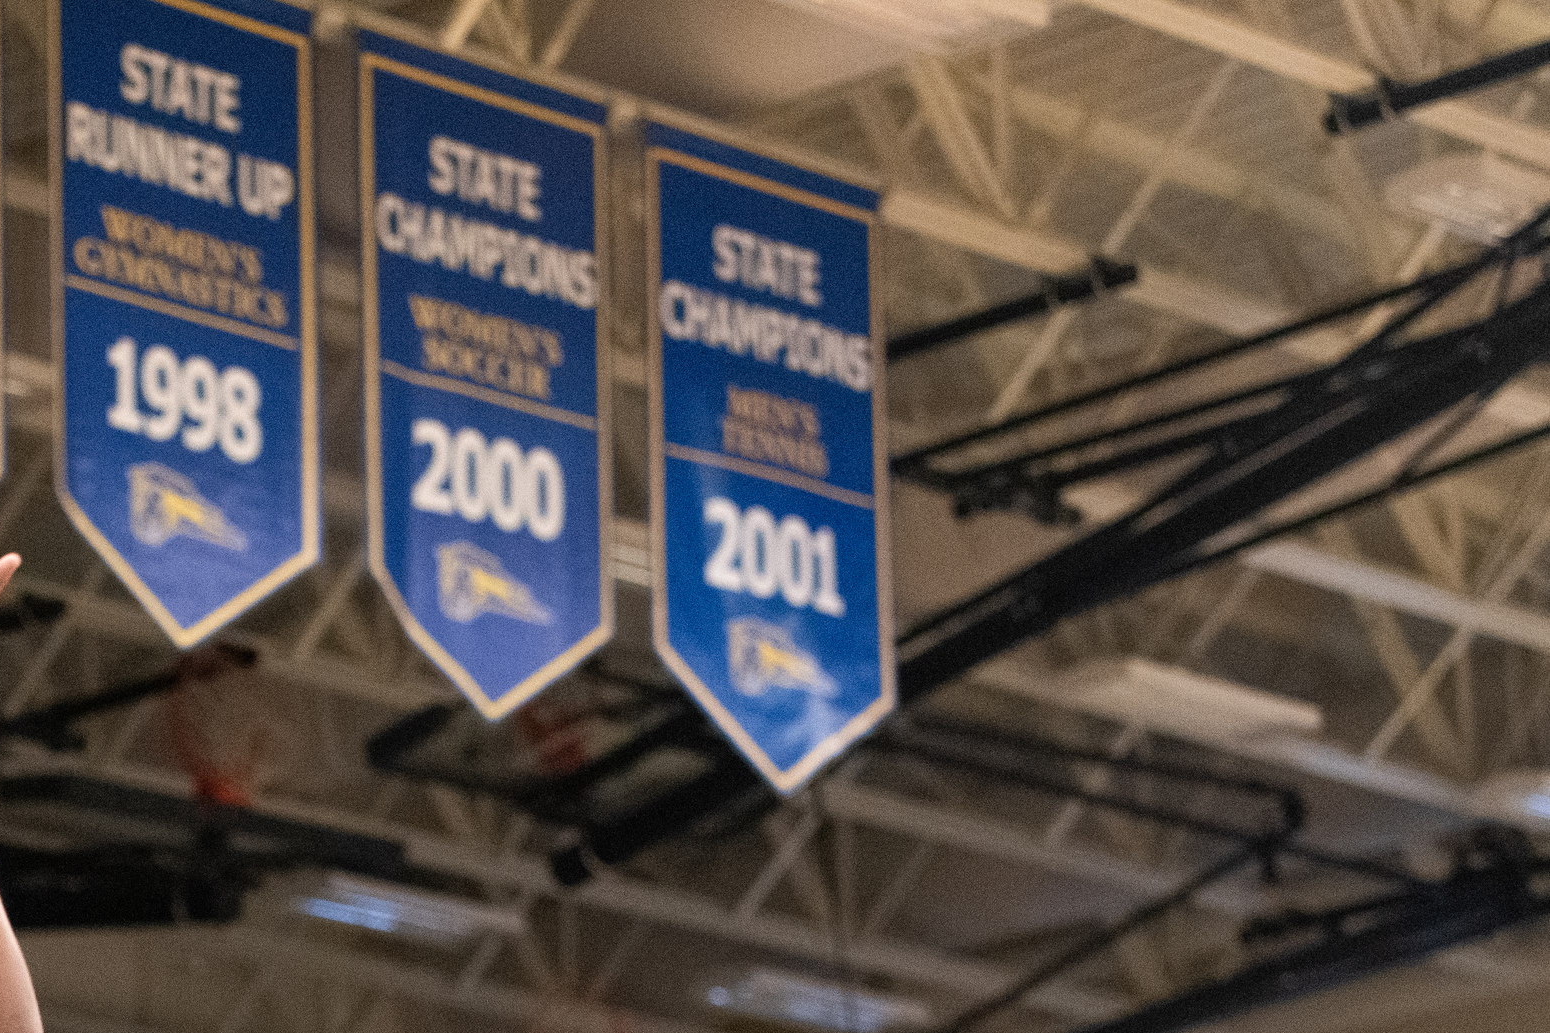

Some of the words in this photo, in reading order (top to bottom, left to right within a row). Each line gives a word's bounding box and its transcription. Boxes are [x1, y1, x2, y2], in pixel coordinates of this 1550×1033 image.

[119, 43, 241, 133] STATE
[65, 100, 233, 206] RUNNER
[236, 154, 296, 220] UP
[428, 135, 543, 222] STATE
[102, 205, 263, 286] WOMEN'S
[375, 191, 598, 309] CHAMPIONS
[711, 223, 823, 307] STATE
[659, 279, 874, 392] CHAMPIONS
[106, 336, 263, 464] 1998
[411, 417, 566, 543] 2000
[703, 495, 847, 618] 2001
